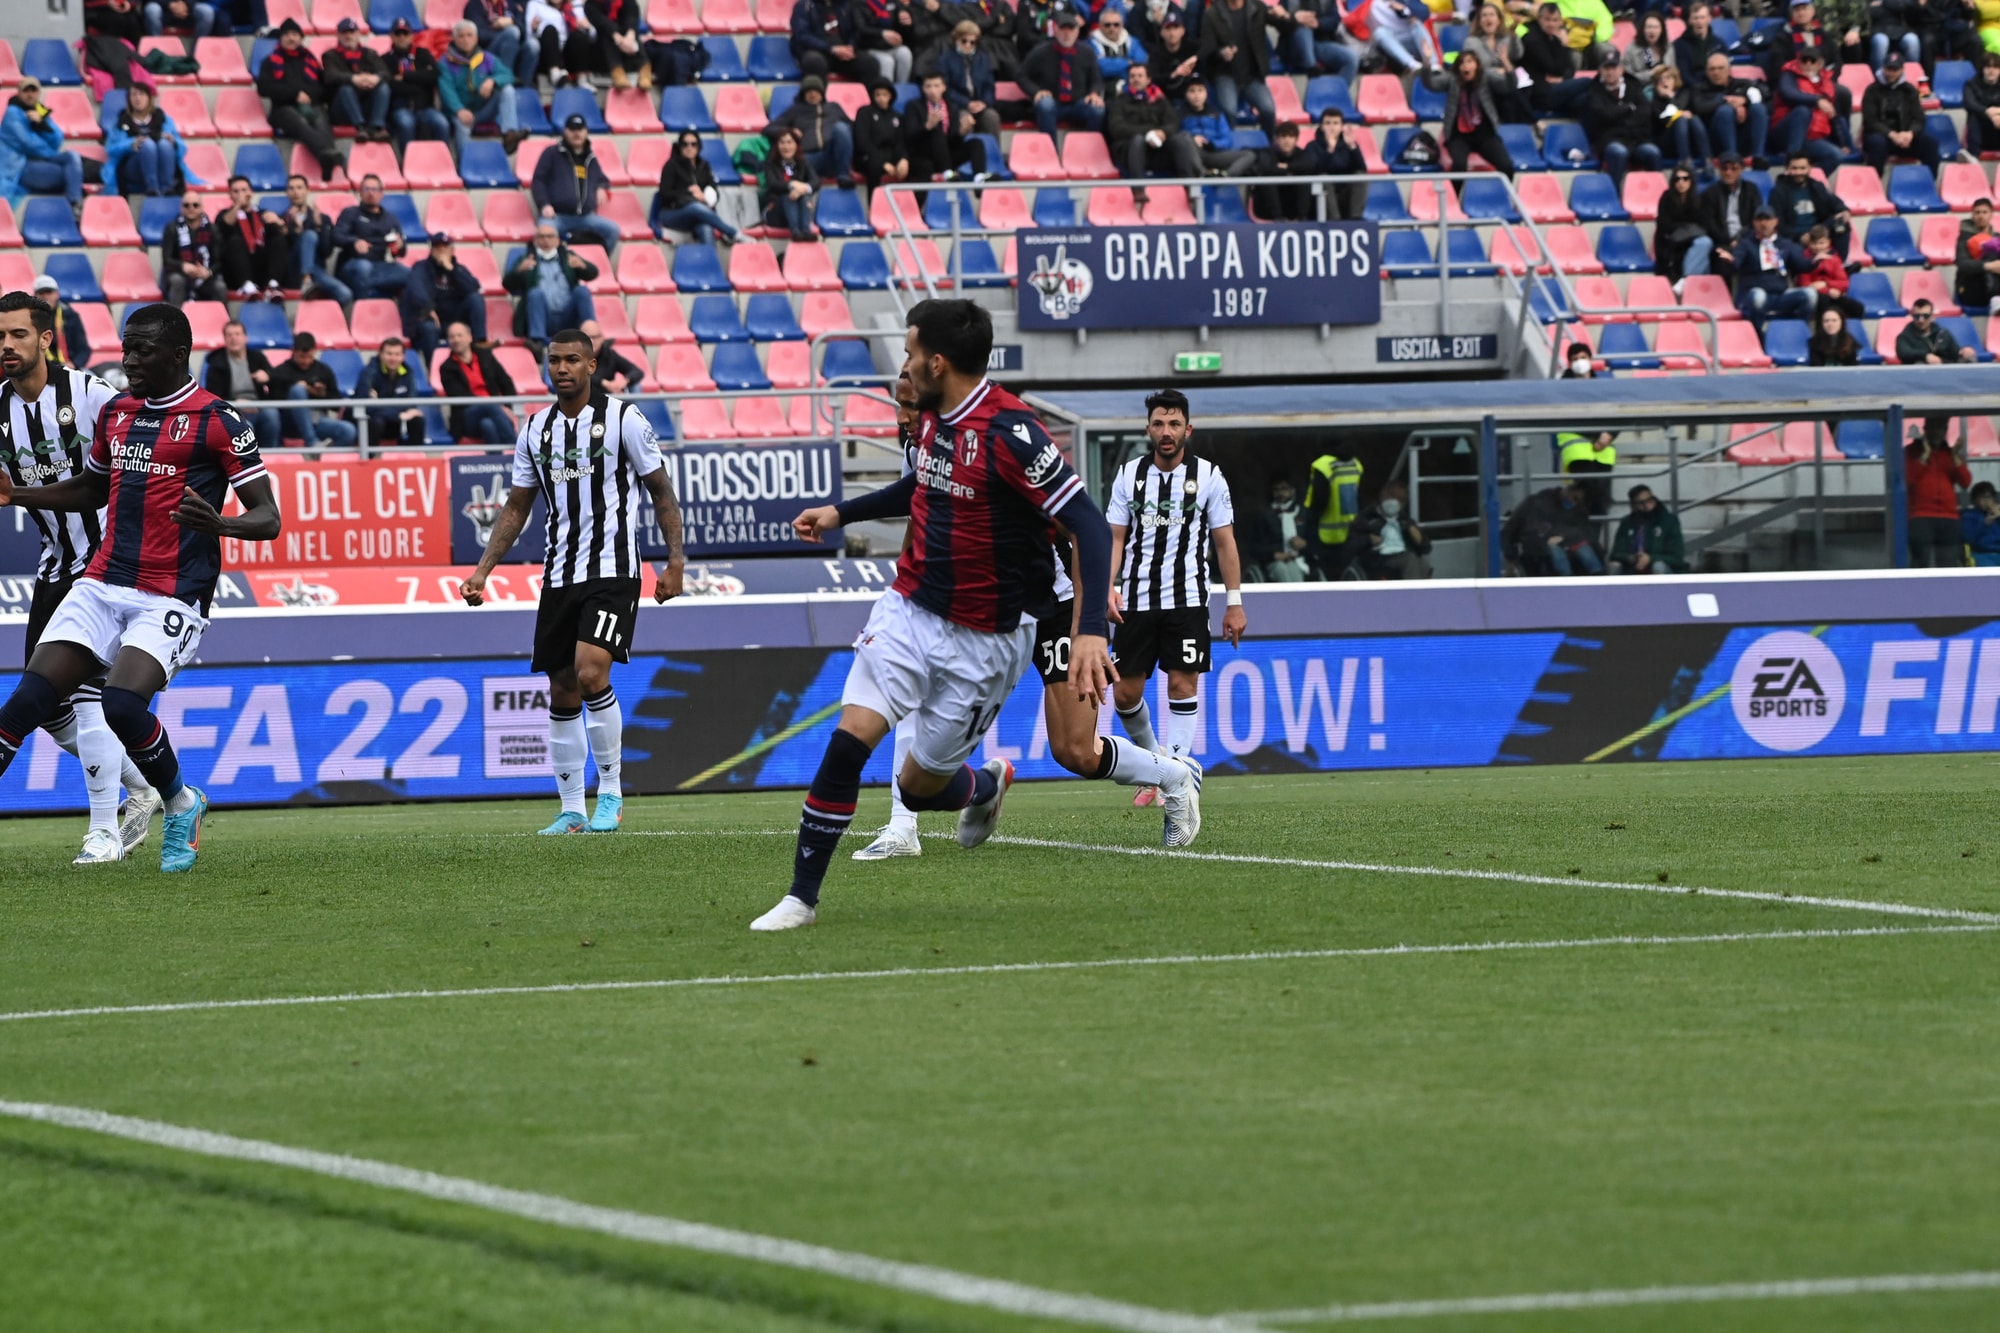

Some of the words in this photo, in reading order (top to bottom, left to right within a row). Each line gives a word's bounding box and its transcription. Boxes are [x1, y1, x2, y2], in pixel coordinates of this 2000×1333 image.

[1105, 233, 1243, 282] GRAPPA
[1258, 229, 1371, 279] KORPS
[1212, 287, 1268, 317] 1987
[1391, 337, 1441, 360] USCITA
[1452, 336, 1482, 358] EXIT
[231, 426, 257, 452] Scal
[683, 448, 833, 503] ROSSOBLU
[295, 469, 361, 521] DEL
[373, 466, 437, 519] CEV
[286, 530, 332, 562] NEL
[344, 526, 425, 560] CUORE
[595, 609, 618, 642] 11
[1041, 636, 1072, 676] 50
[1182, 638, 1196, 665] 5
[1751, 657, 1825, 697] EA
[494, 690, 549, 711] FIFA
[1750, 698, 1827, 718] SPORTS
[317, 679, 468, 781] 22
[964, 702, 1001, 741] 10
[500, 736, 543, 744] OFFICIAL
[500, 746, 547, 755] LICENSED
[500, 757, 546, 766] PRODUCT
